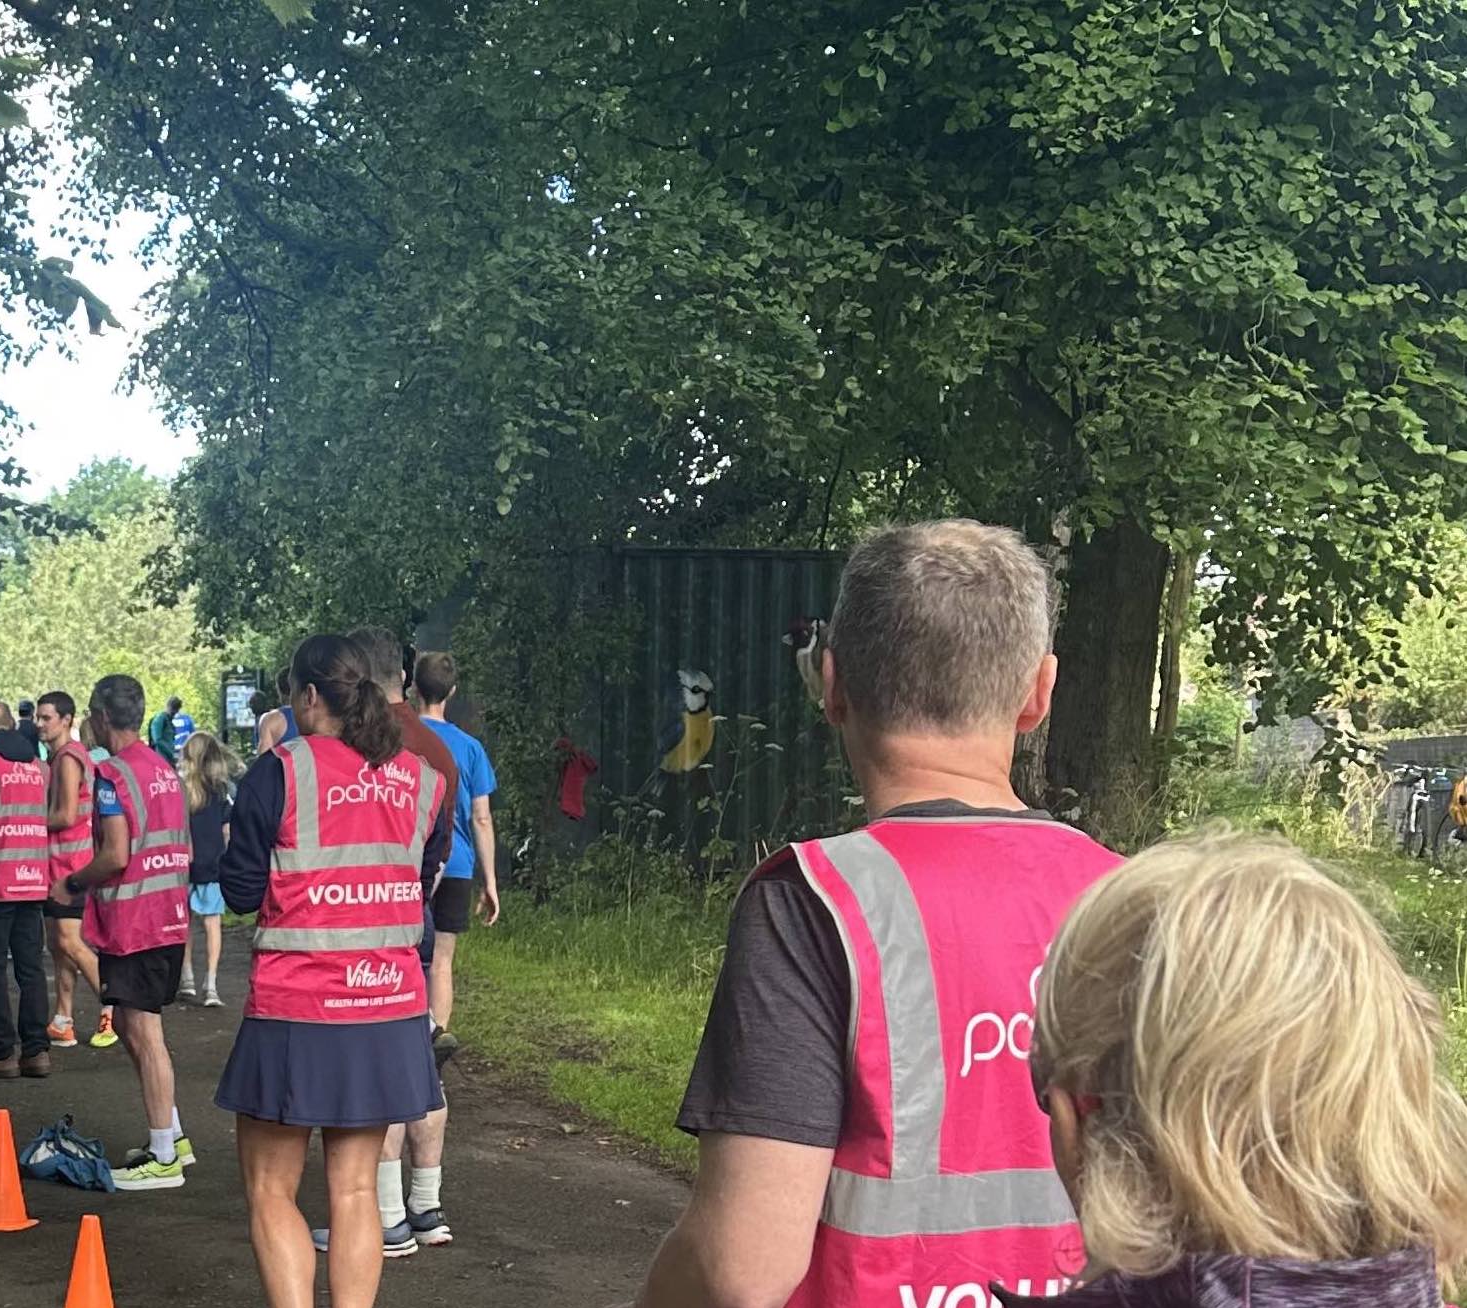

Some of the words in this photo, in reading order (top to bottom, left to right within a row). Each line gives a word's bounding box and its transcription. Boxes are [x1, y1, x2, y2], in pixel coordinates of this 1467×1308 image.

[327, 762, 413, 812] parkrun
[384, 762, 416, 790] Vitality
[308, 881, 422, 905] VOLUNTEER
[346, 958, 404, 992] Vitality
